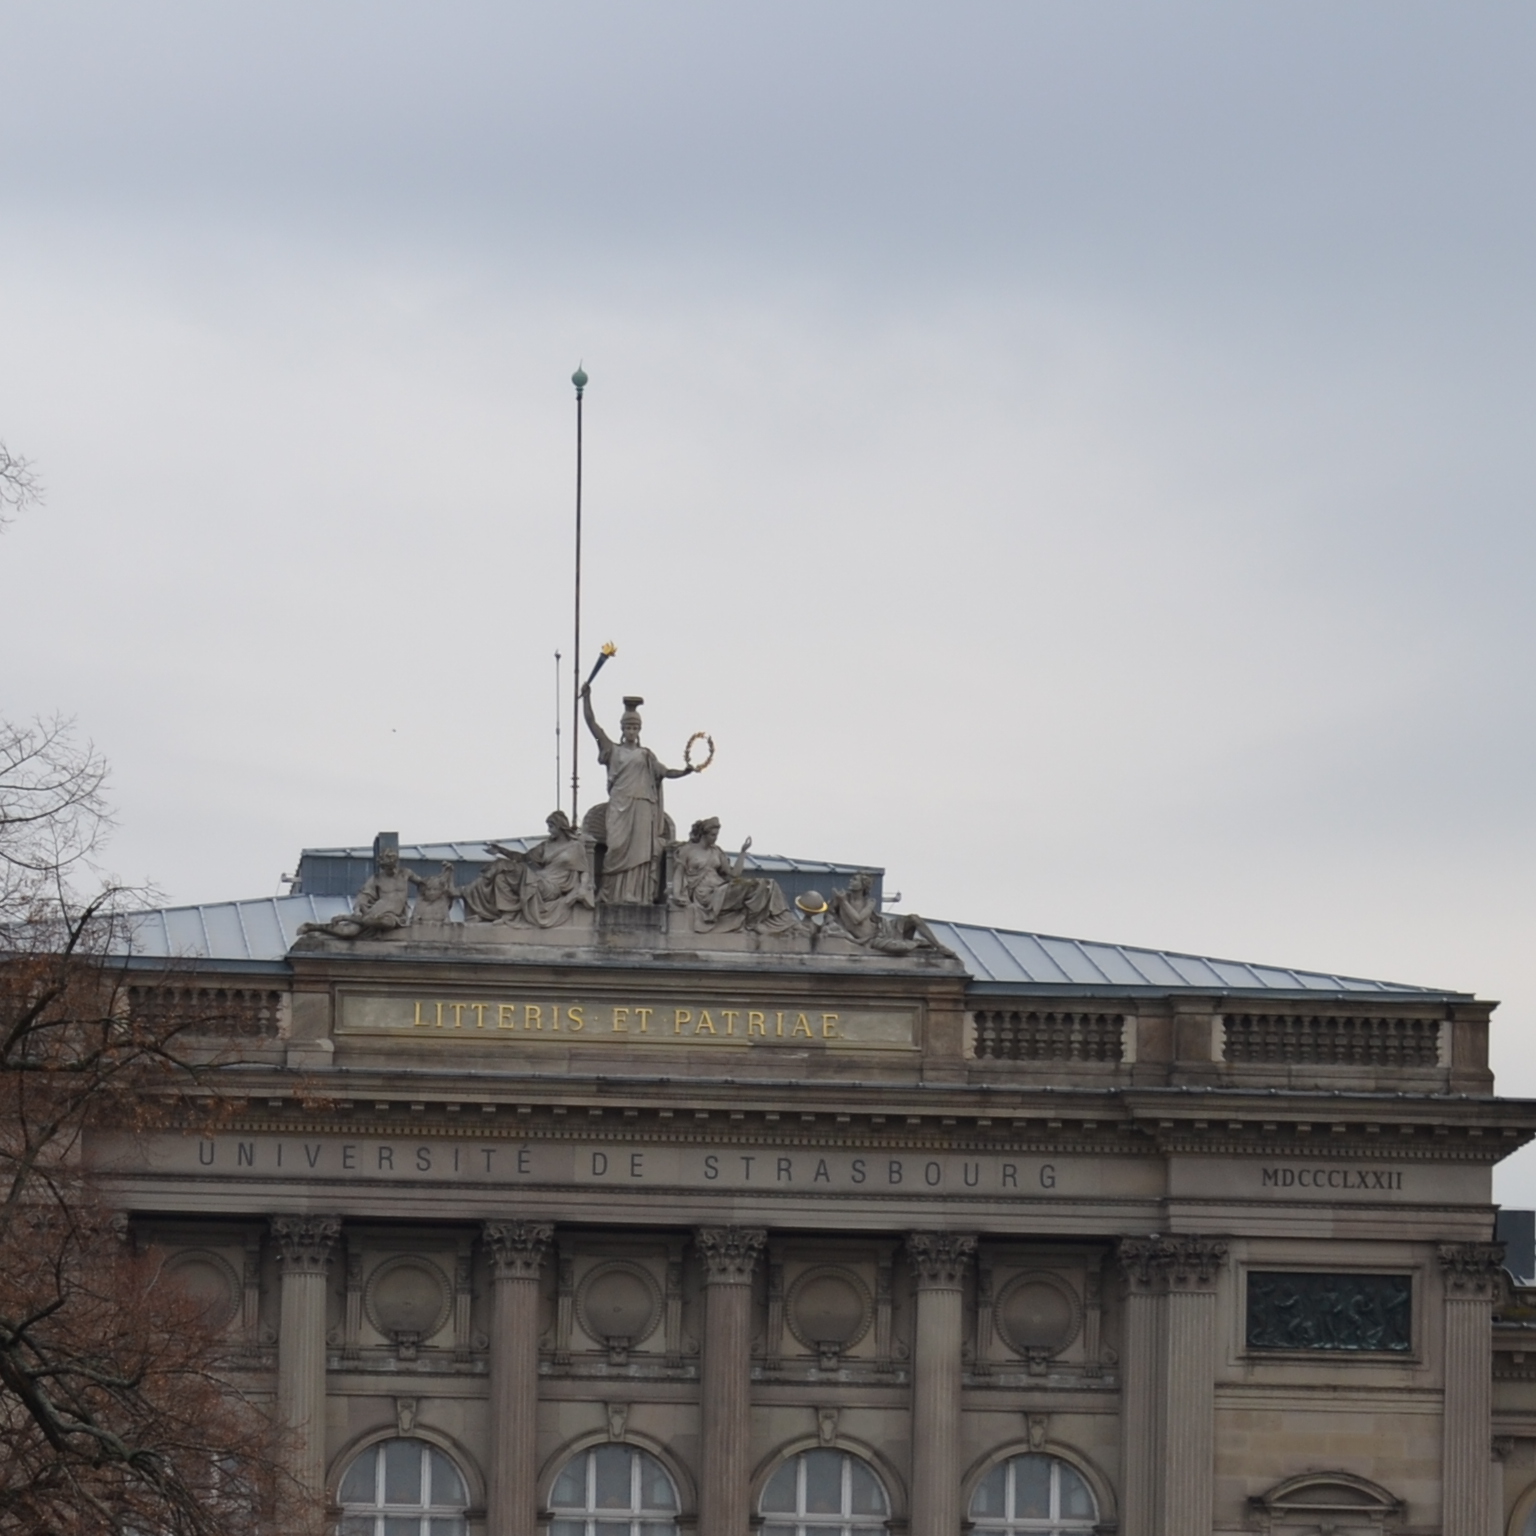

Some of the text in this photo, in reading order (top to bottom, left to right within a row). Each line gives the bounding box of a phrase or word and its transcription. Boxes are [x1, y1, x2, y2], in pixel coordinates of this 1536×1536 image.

[413, 1002, 584, 1032] LITTERIS
[611, 1007, 654, 1033] ET
[198, 1140, 1056, 1190] UNIVERSITÉ DE STRASBOURG
[1261, 1168, 1404, 1191] MDCCCLXXII
